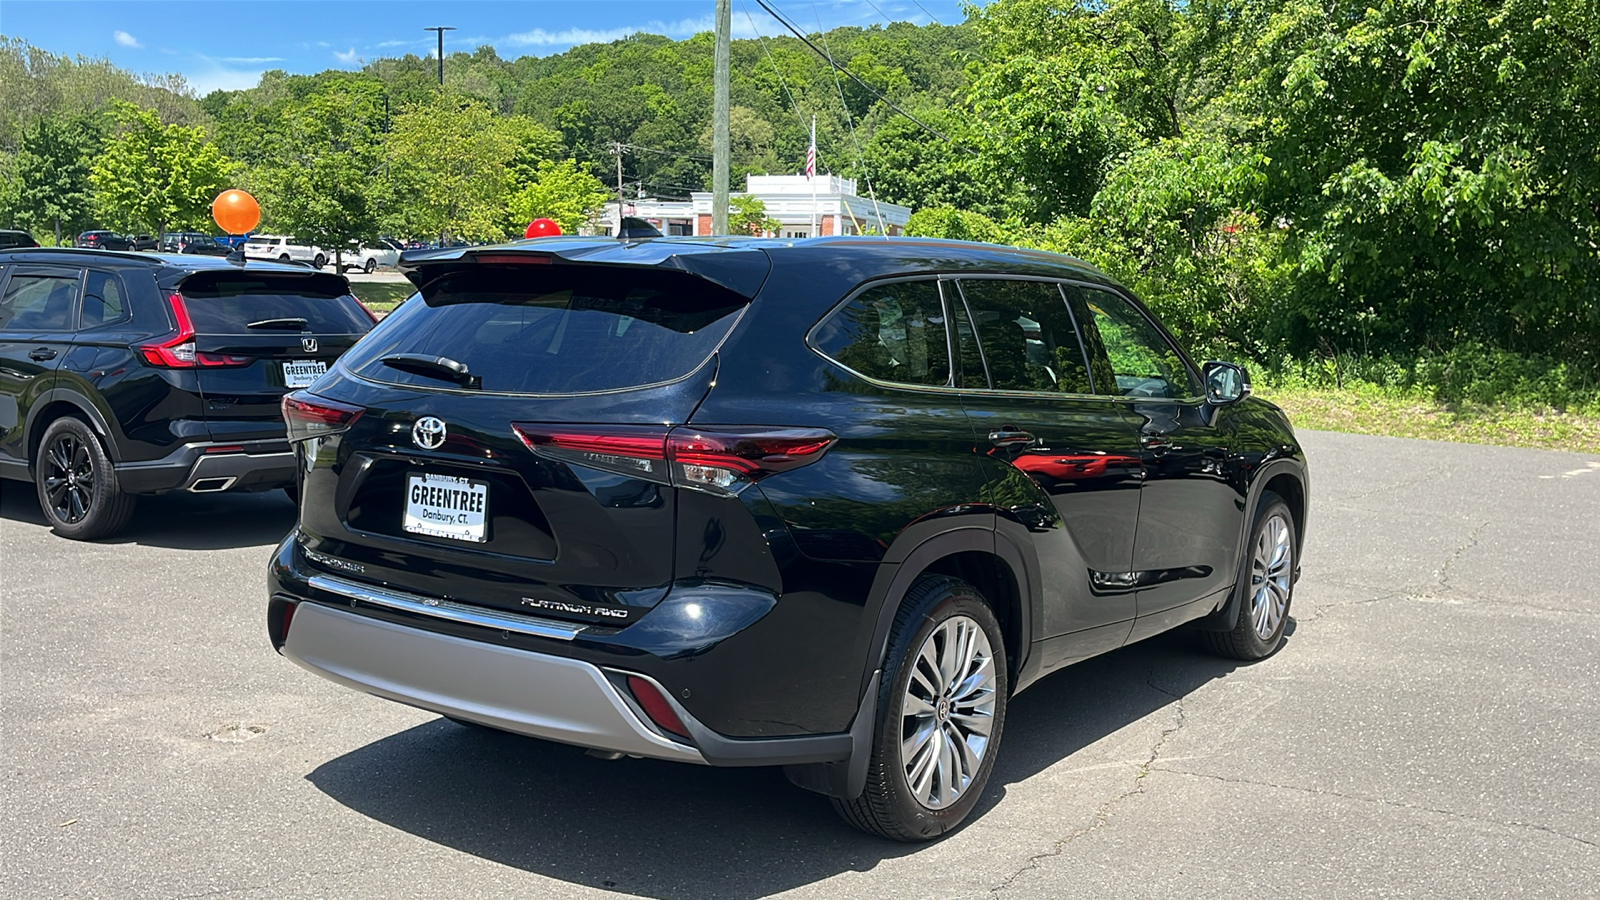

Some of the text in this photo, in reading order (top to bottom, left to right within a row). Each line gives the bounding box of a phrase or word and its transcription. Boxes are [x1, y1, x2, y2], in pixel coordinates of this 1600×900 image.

[285, 365, 325, 375] GREENTREE
[411, 485, 483, 513] GREENTREE
[423, 508, 468, 525] Danbury, CT.
[521, 597, 628, 618] PLATINUM AWD
